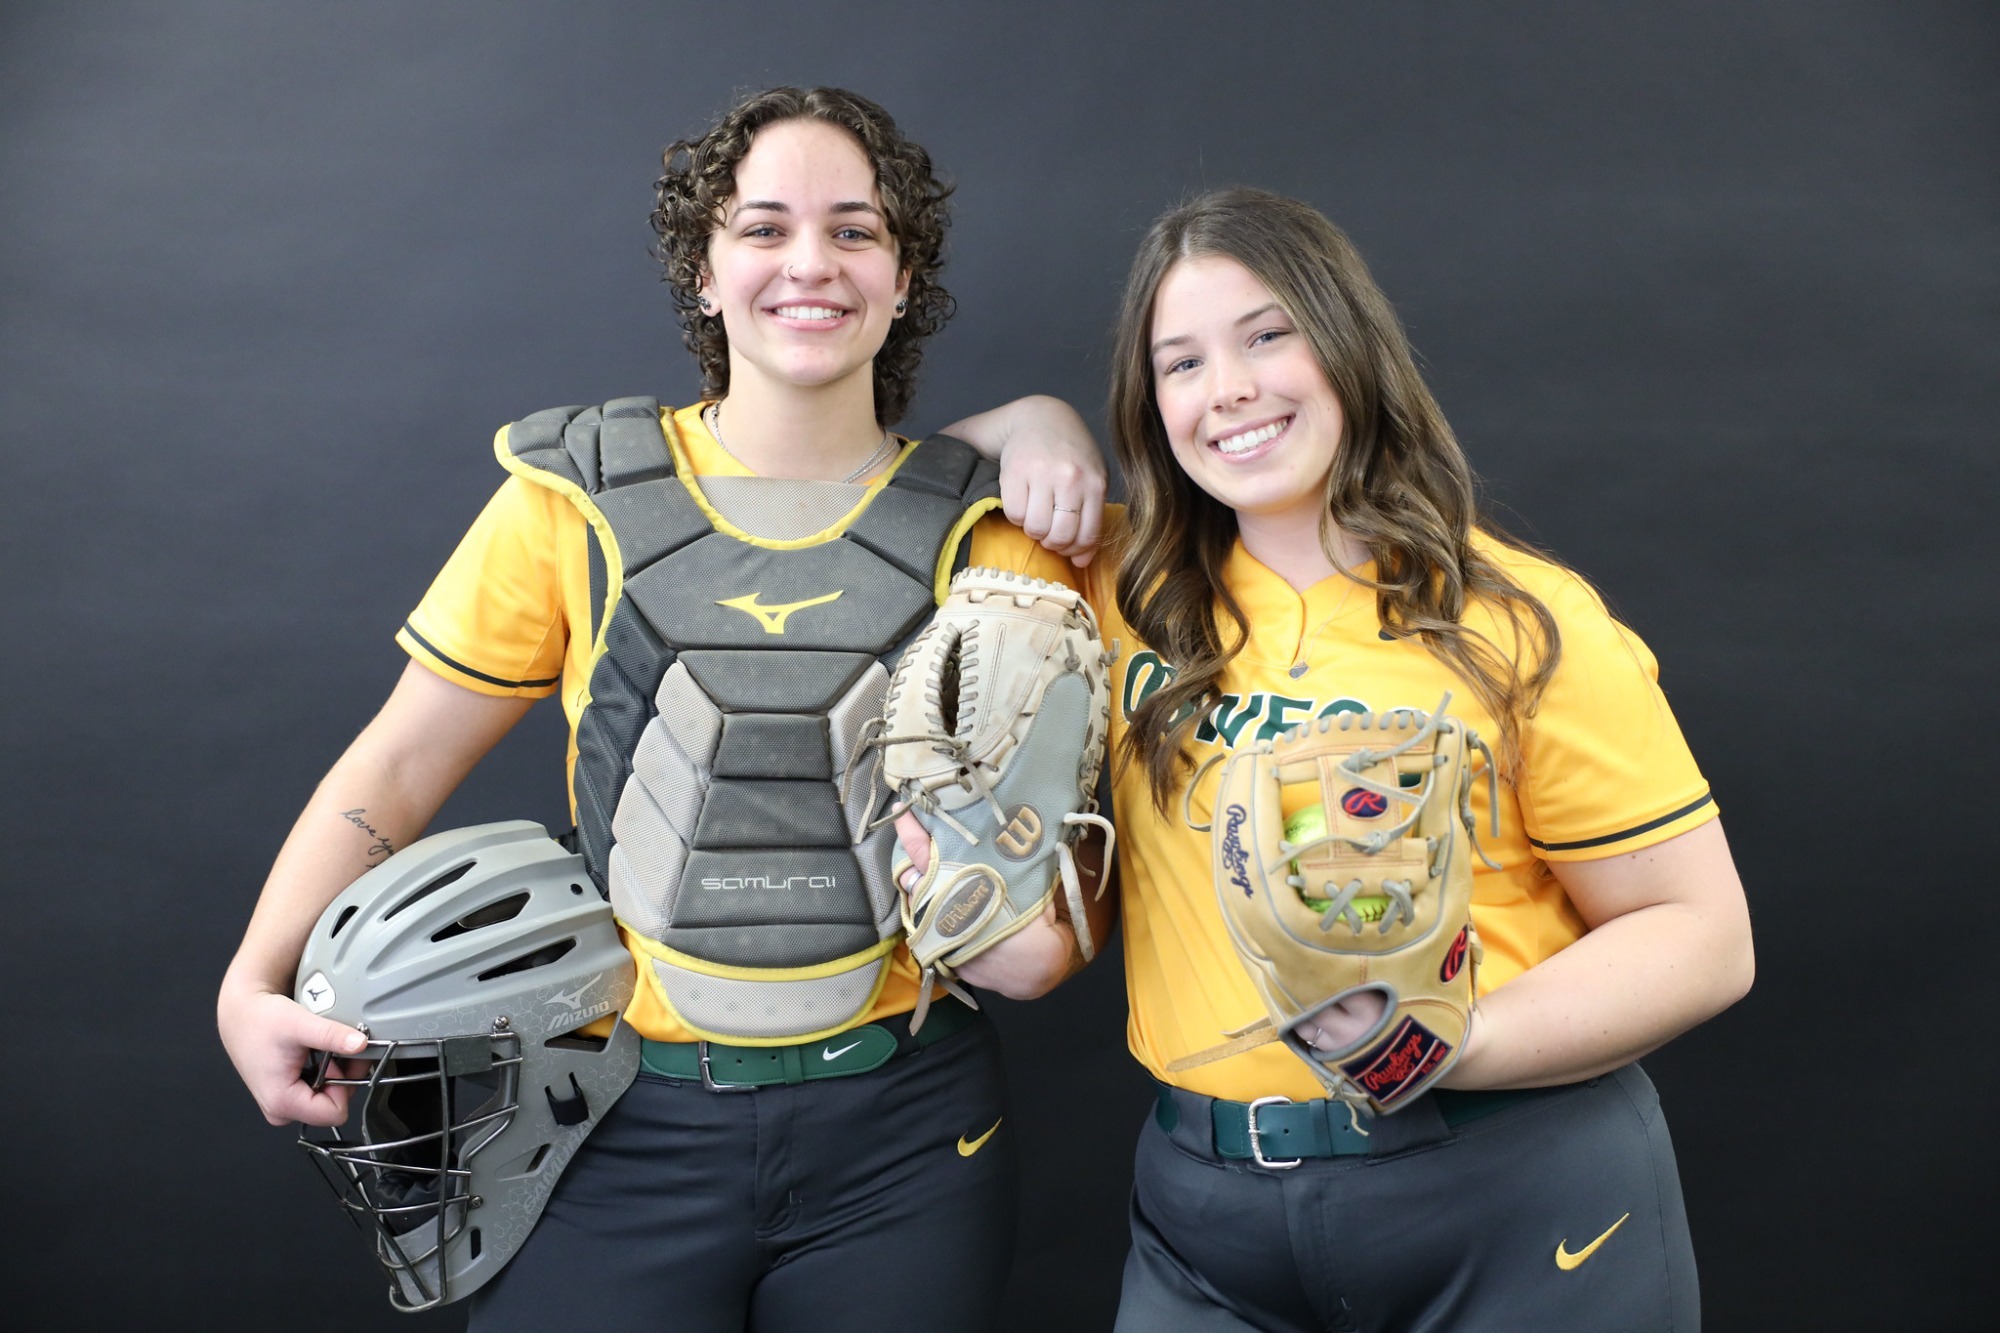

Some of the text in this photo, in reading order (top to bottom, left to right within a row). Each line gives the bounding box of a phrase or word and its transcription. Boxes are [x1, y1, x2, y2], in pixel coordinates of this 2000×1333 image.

[339, 808, 377, 838] love
[1221, 803, 1254, 900] Rawlings
[938, 878, 990, 936] Wilson
[1364, 1033, 1422, 1091] Rawlings
